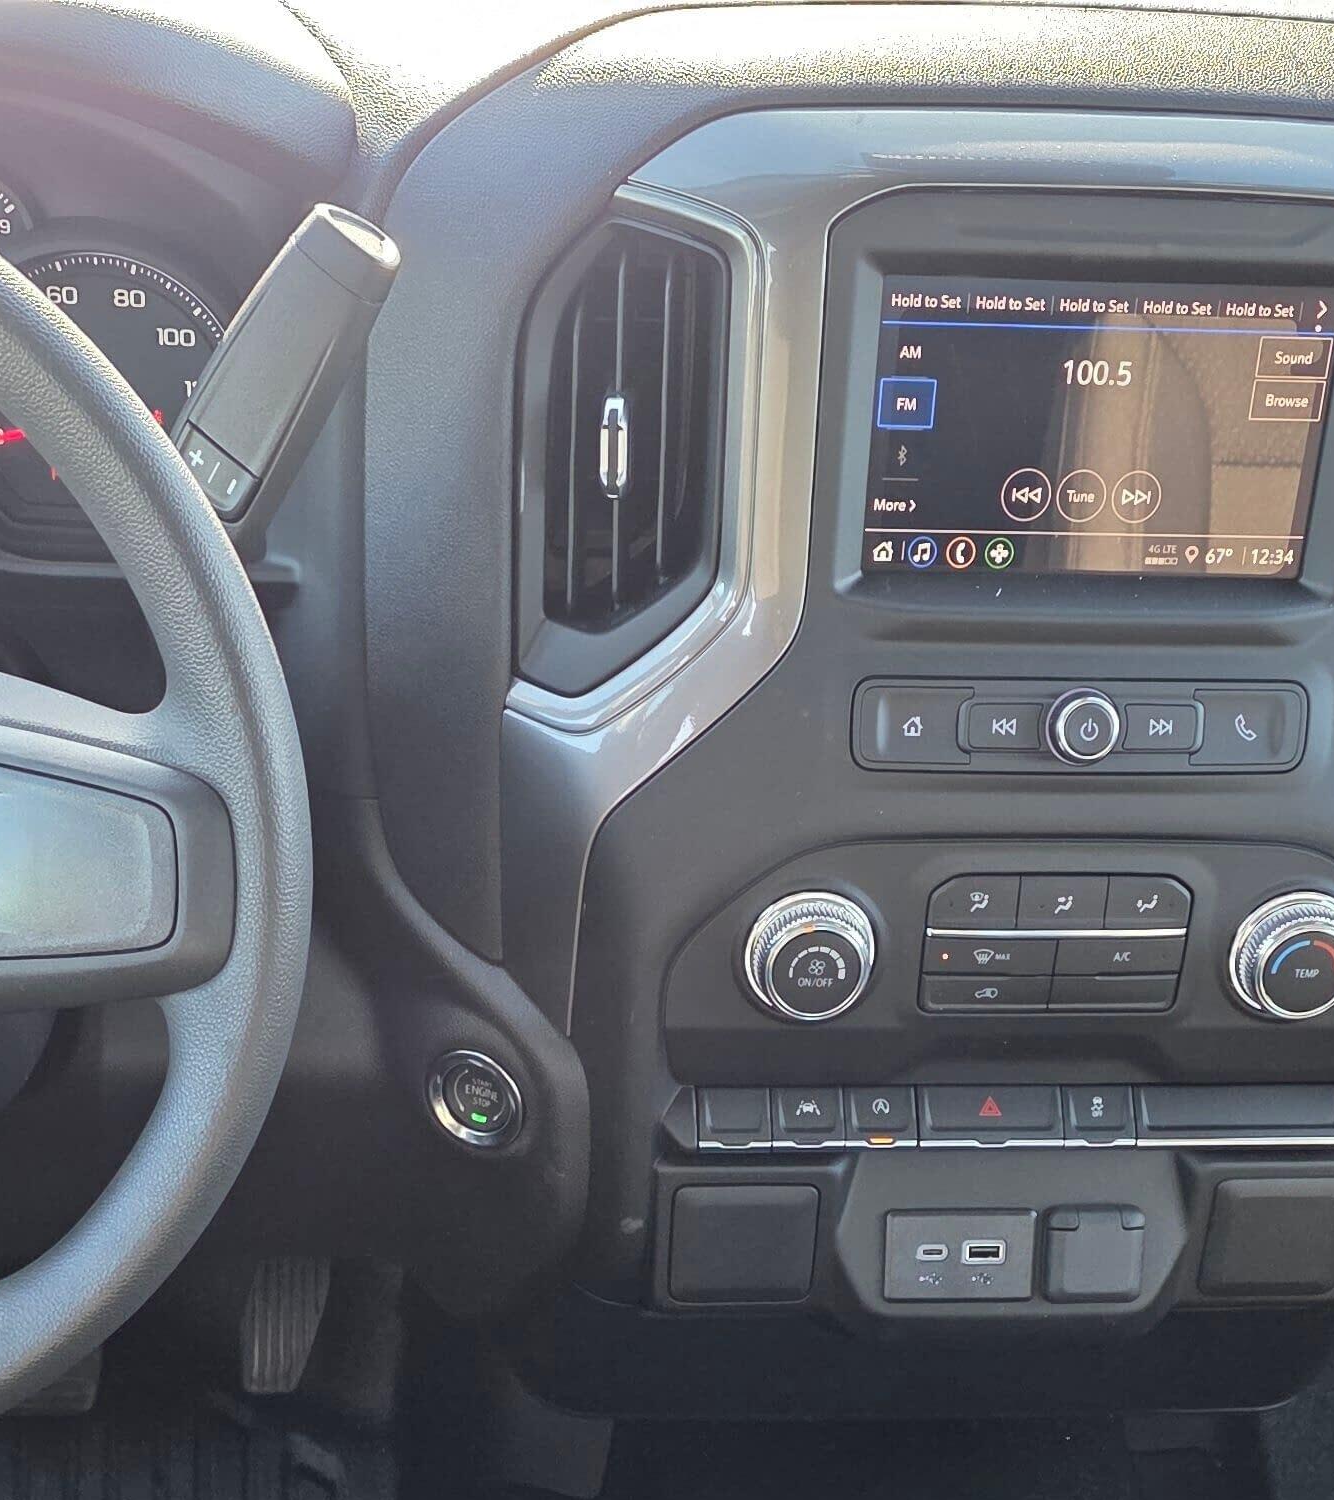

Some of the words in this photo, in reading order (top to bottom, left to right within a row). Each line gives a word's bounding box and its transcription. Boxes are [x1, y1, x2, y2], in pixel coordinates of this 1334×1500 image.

[46, 286, 78, 305] 60
[113, 289, 146, 308] 80
[891, 293, 922, 308] Hold
[924, 295, 938, 308] to
[940, 294, 962, 309] Set
[976, 296, 1006, 310] Hold
[1008, 297, 1022, 311] to
[1024, 297, 1046, 312] Set
[1059, 298, 1090, 313] Hold
[1092, 300, 1106, 313] to
[1108, 299, 1130, 314] Set
[1143, 300, 1173, 315] Hold
[1175, 302, 1189, 316] to
[1191, 301, 1212, 316] Set
[1225, 302, 1256, 317] Hold
[1258, 304, 1272, 317] to
[1273, 303, 1295, 318] Set
[156, 327, 196, 347] 100
[899, 345, 922, 359] AM
[1274, 351, 1314, 365] Sound
[1063, 359, 1133, 387] 100.5
[896, 397, 917, 411] FM
[1265, 394, 1309, 408] Browse
[1067, 489, 1095, 503] Tune
[873, 498, 907, 512] More
[1148, 545, 1161, 554] 4G
[1162, 545, 1178, 554] LTE
[1204, 548, 1234, 565] 67°
[1251, 548, 1294, 565] 12:34
[995, 953, 1011, 961] MAX
[1113, 951, 1132, 962] A/C
[1295, 968, 1320, 979] TEMP
[797, 978, 834, 988] ON/OFF
[465, 1084, 499, 1102] ENGINE
[472, 1097, 491, 1107] STOP
